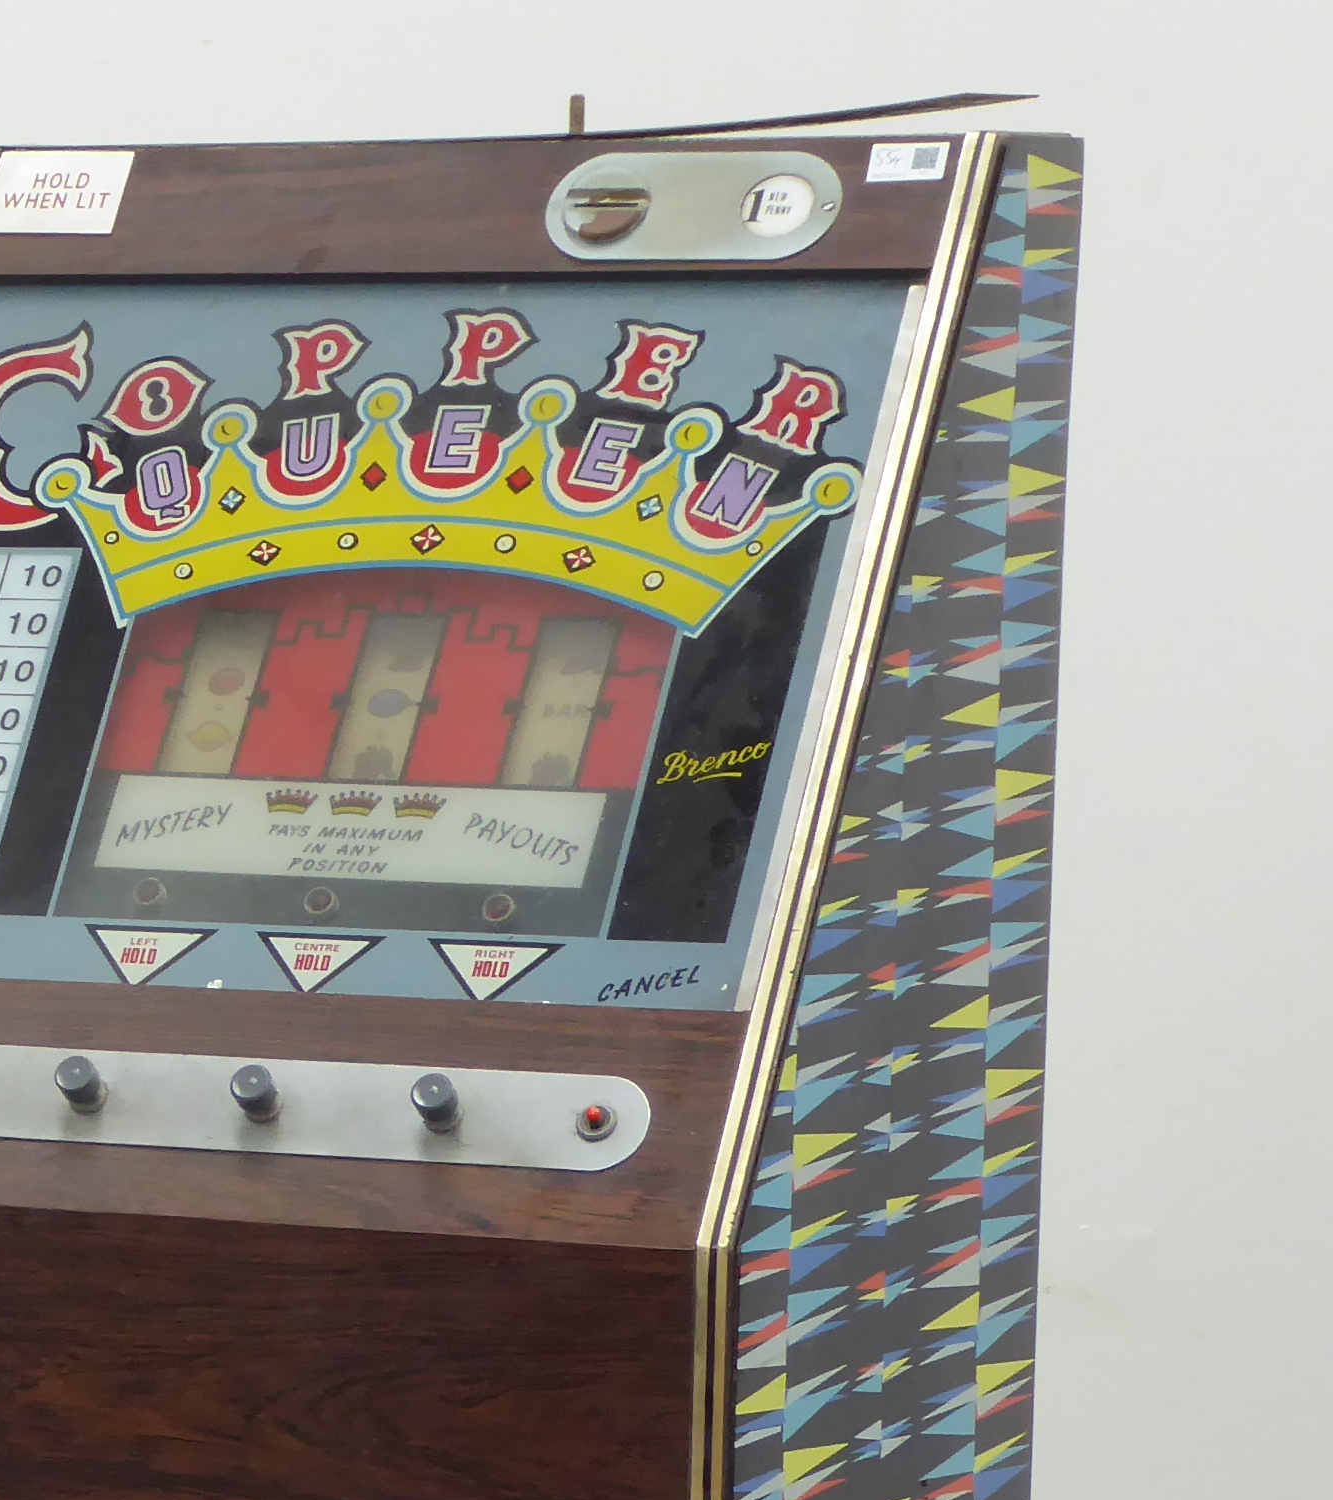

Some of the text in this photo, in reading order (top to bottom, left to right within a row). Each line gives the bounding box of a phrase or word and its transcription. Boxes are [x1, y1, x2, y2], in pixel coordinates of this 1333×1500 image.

[32, 172, 91, 190] HOLD
[3, 192, 111, 209] WHEN LIT
[743, 188, 789, 224] 1 NEW
[764, 204, 793, 216] PENNY
[141, 405, 775, 534] QUEEN
[23, 564, 63, 588] 10
[8, 612, 48, 636] 10
[656, 741, 773, 786] Brenco
[115, 802, 233, 848] MYSTERY
[268, 824, 424, 842] PAYS MAXIMUM
[463, 812, 580, 866] PAYOUTS
[302, 843, 381, 857] IN ANY
[287, 857, 389, 875] POSITION
[130, 937, 160, 947] LEFT
[293, 942, 341, 953] CENTRE
[120, 947, 158, 966] HOLD
[293, 953, 332, 972] HOLD
[474, 949, 516, 960] RIGHT
[471, 960, 510, 978] HOLD
[596, 965, 701, 1003] CANCEL
